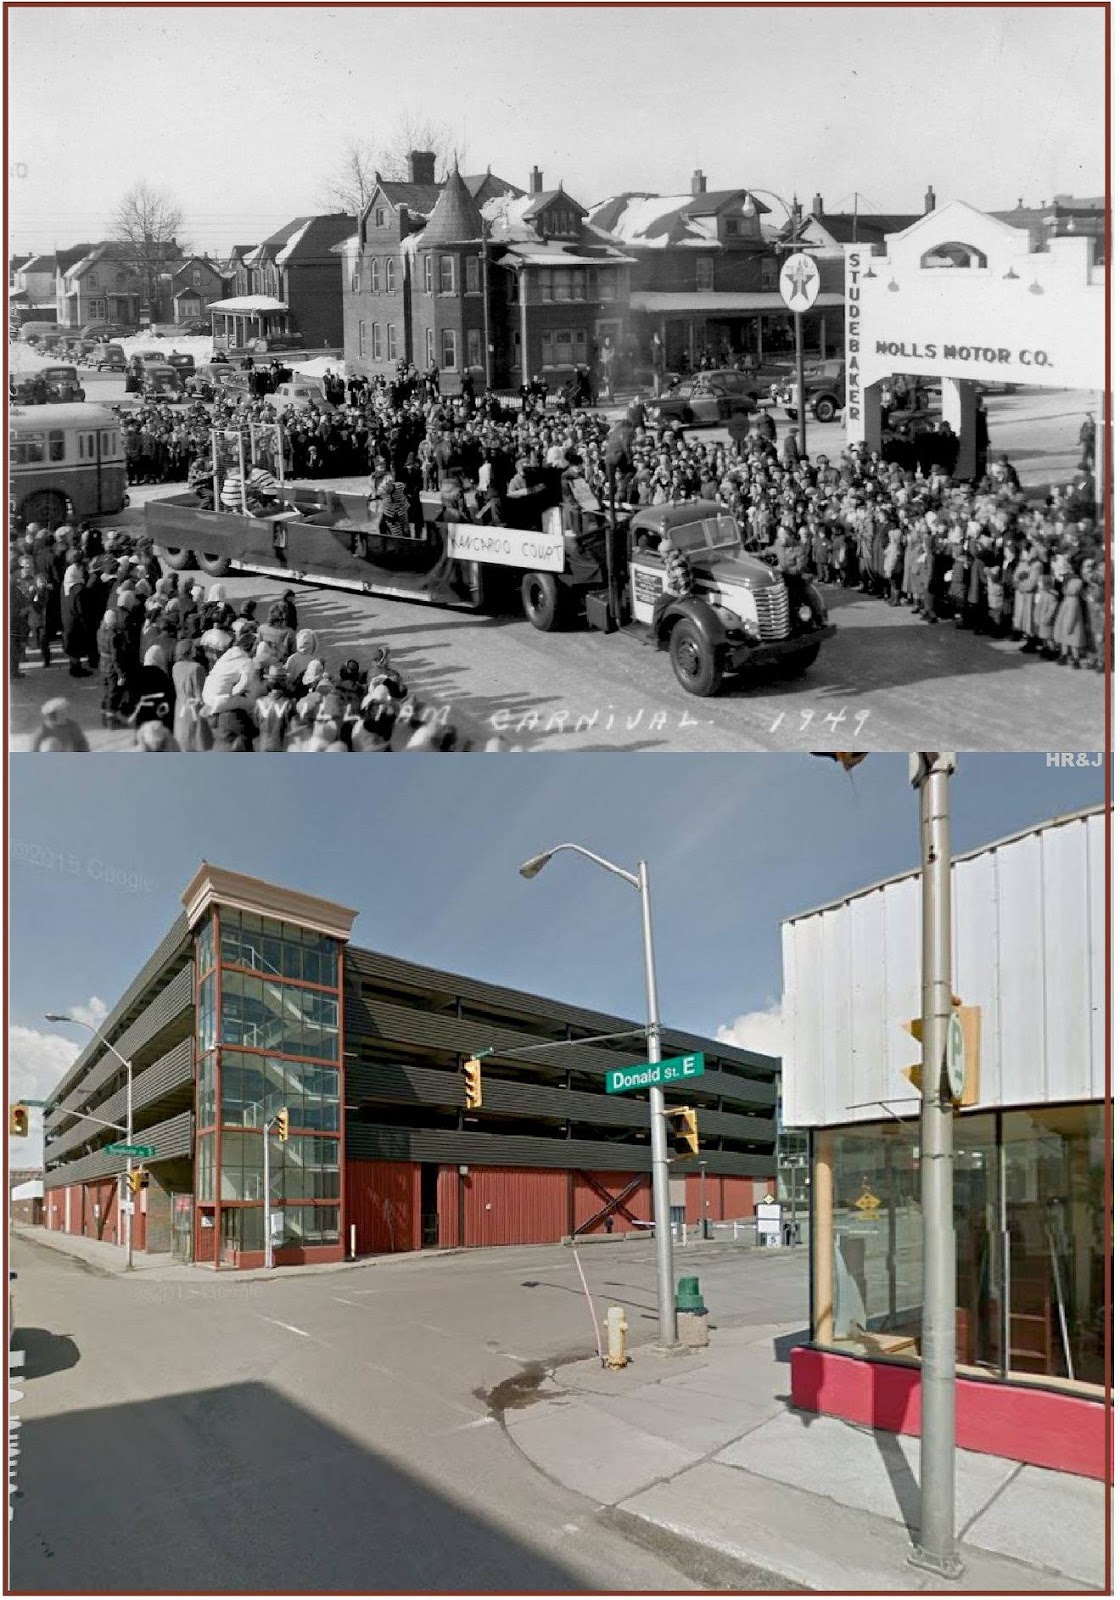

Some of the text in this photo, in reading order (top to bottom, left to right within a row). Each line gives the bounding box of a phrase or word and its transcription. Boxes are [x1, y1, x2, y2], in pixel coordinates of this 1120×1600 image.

[849, 253, 860, 420] STUDEBAKER
[943, 344, 1011, 364] MOTOR
[1019, 350, 1054, 367] CO.
[522, 542, 562, 562] COURT
[613, 1056, 696, 1089] Donald St. E
